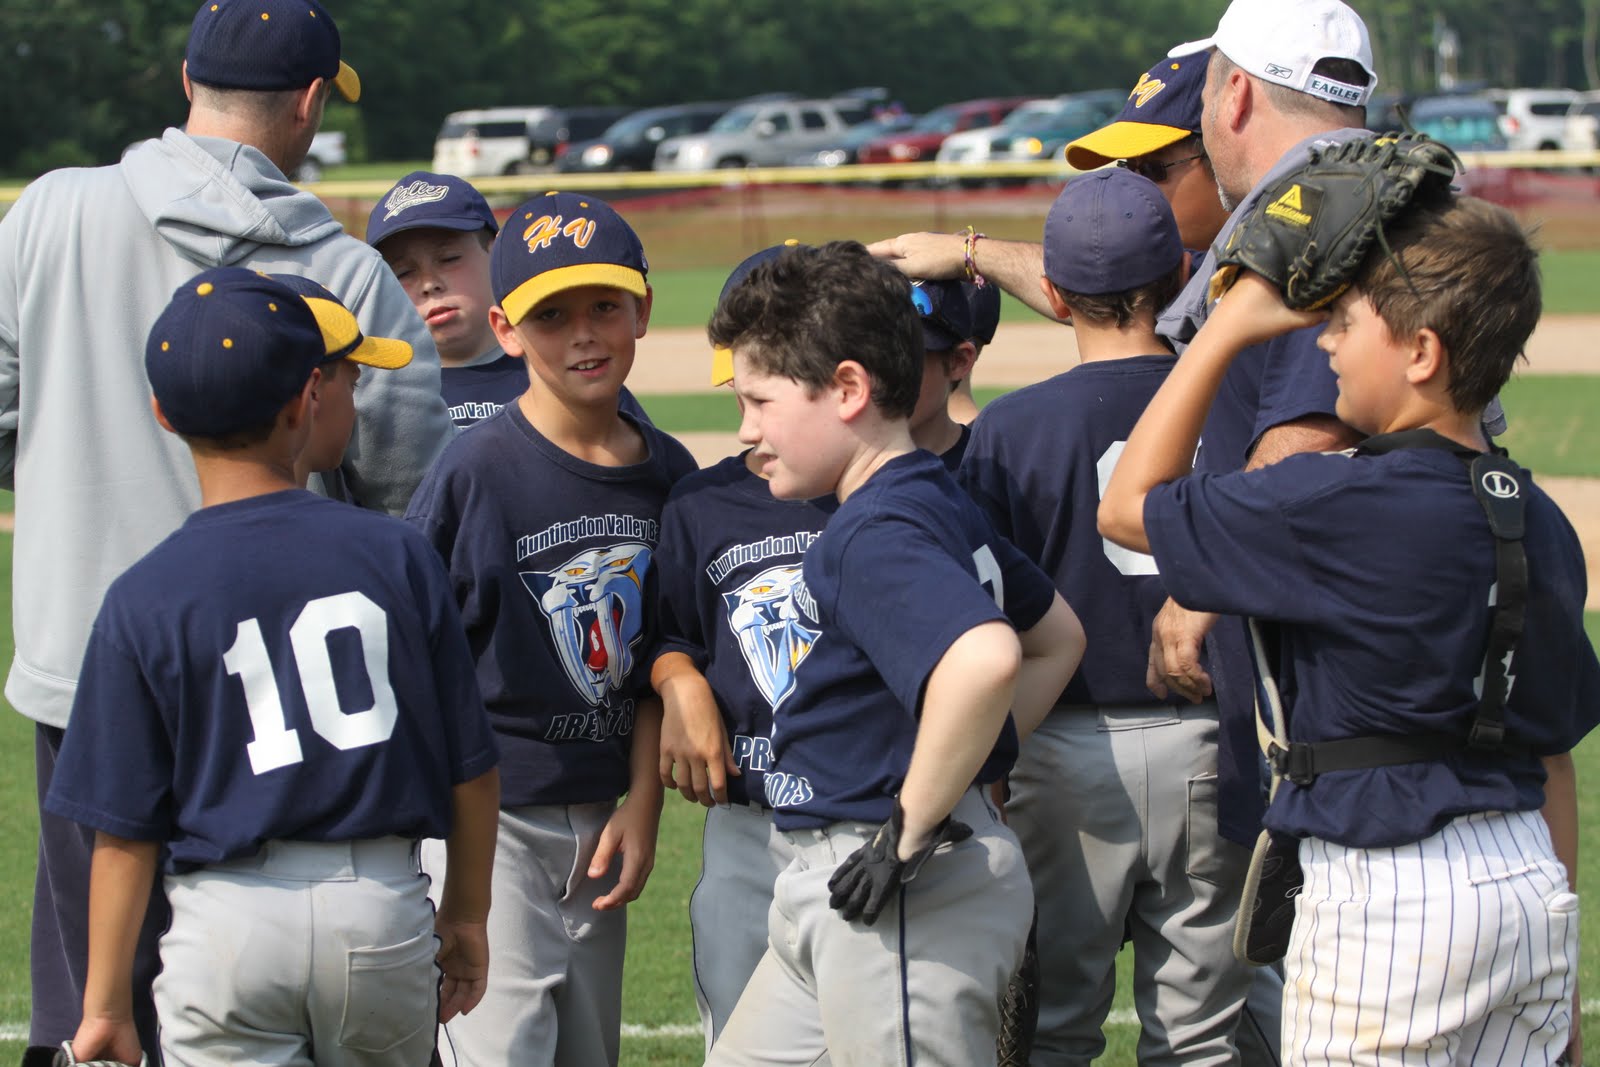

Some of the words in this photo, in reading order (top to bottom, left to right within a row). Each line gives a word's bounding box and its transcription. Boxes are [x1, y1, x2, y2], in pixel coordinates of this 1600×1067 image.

[1311, 80, 1360, 101] EAGLES
[385, 180, 449, 210] Valley
[447, 405, 466, 420] on
[516, 515, 604, 562] Huntingdon
[605, 513, 649, 540] Valley
[705, 536, 796, 586] Huntingdon
[222, 590, 399, 776] 10
